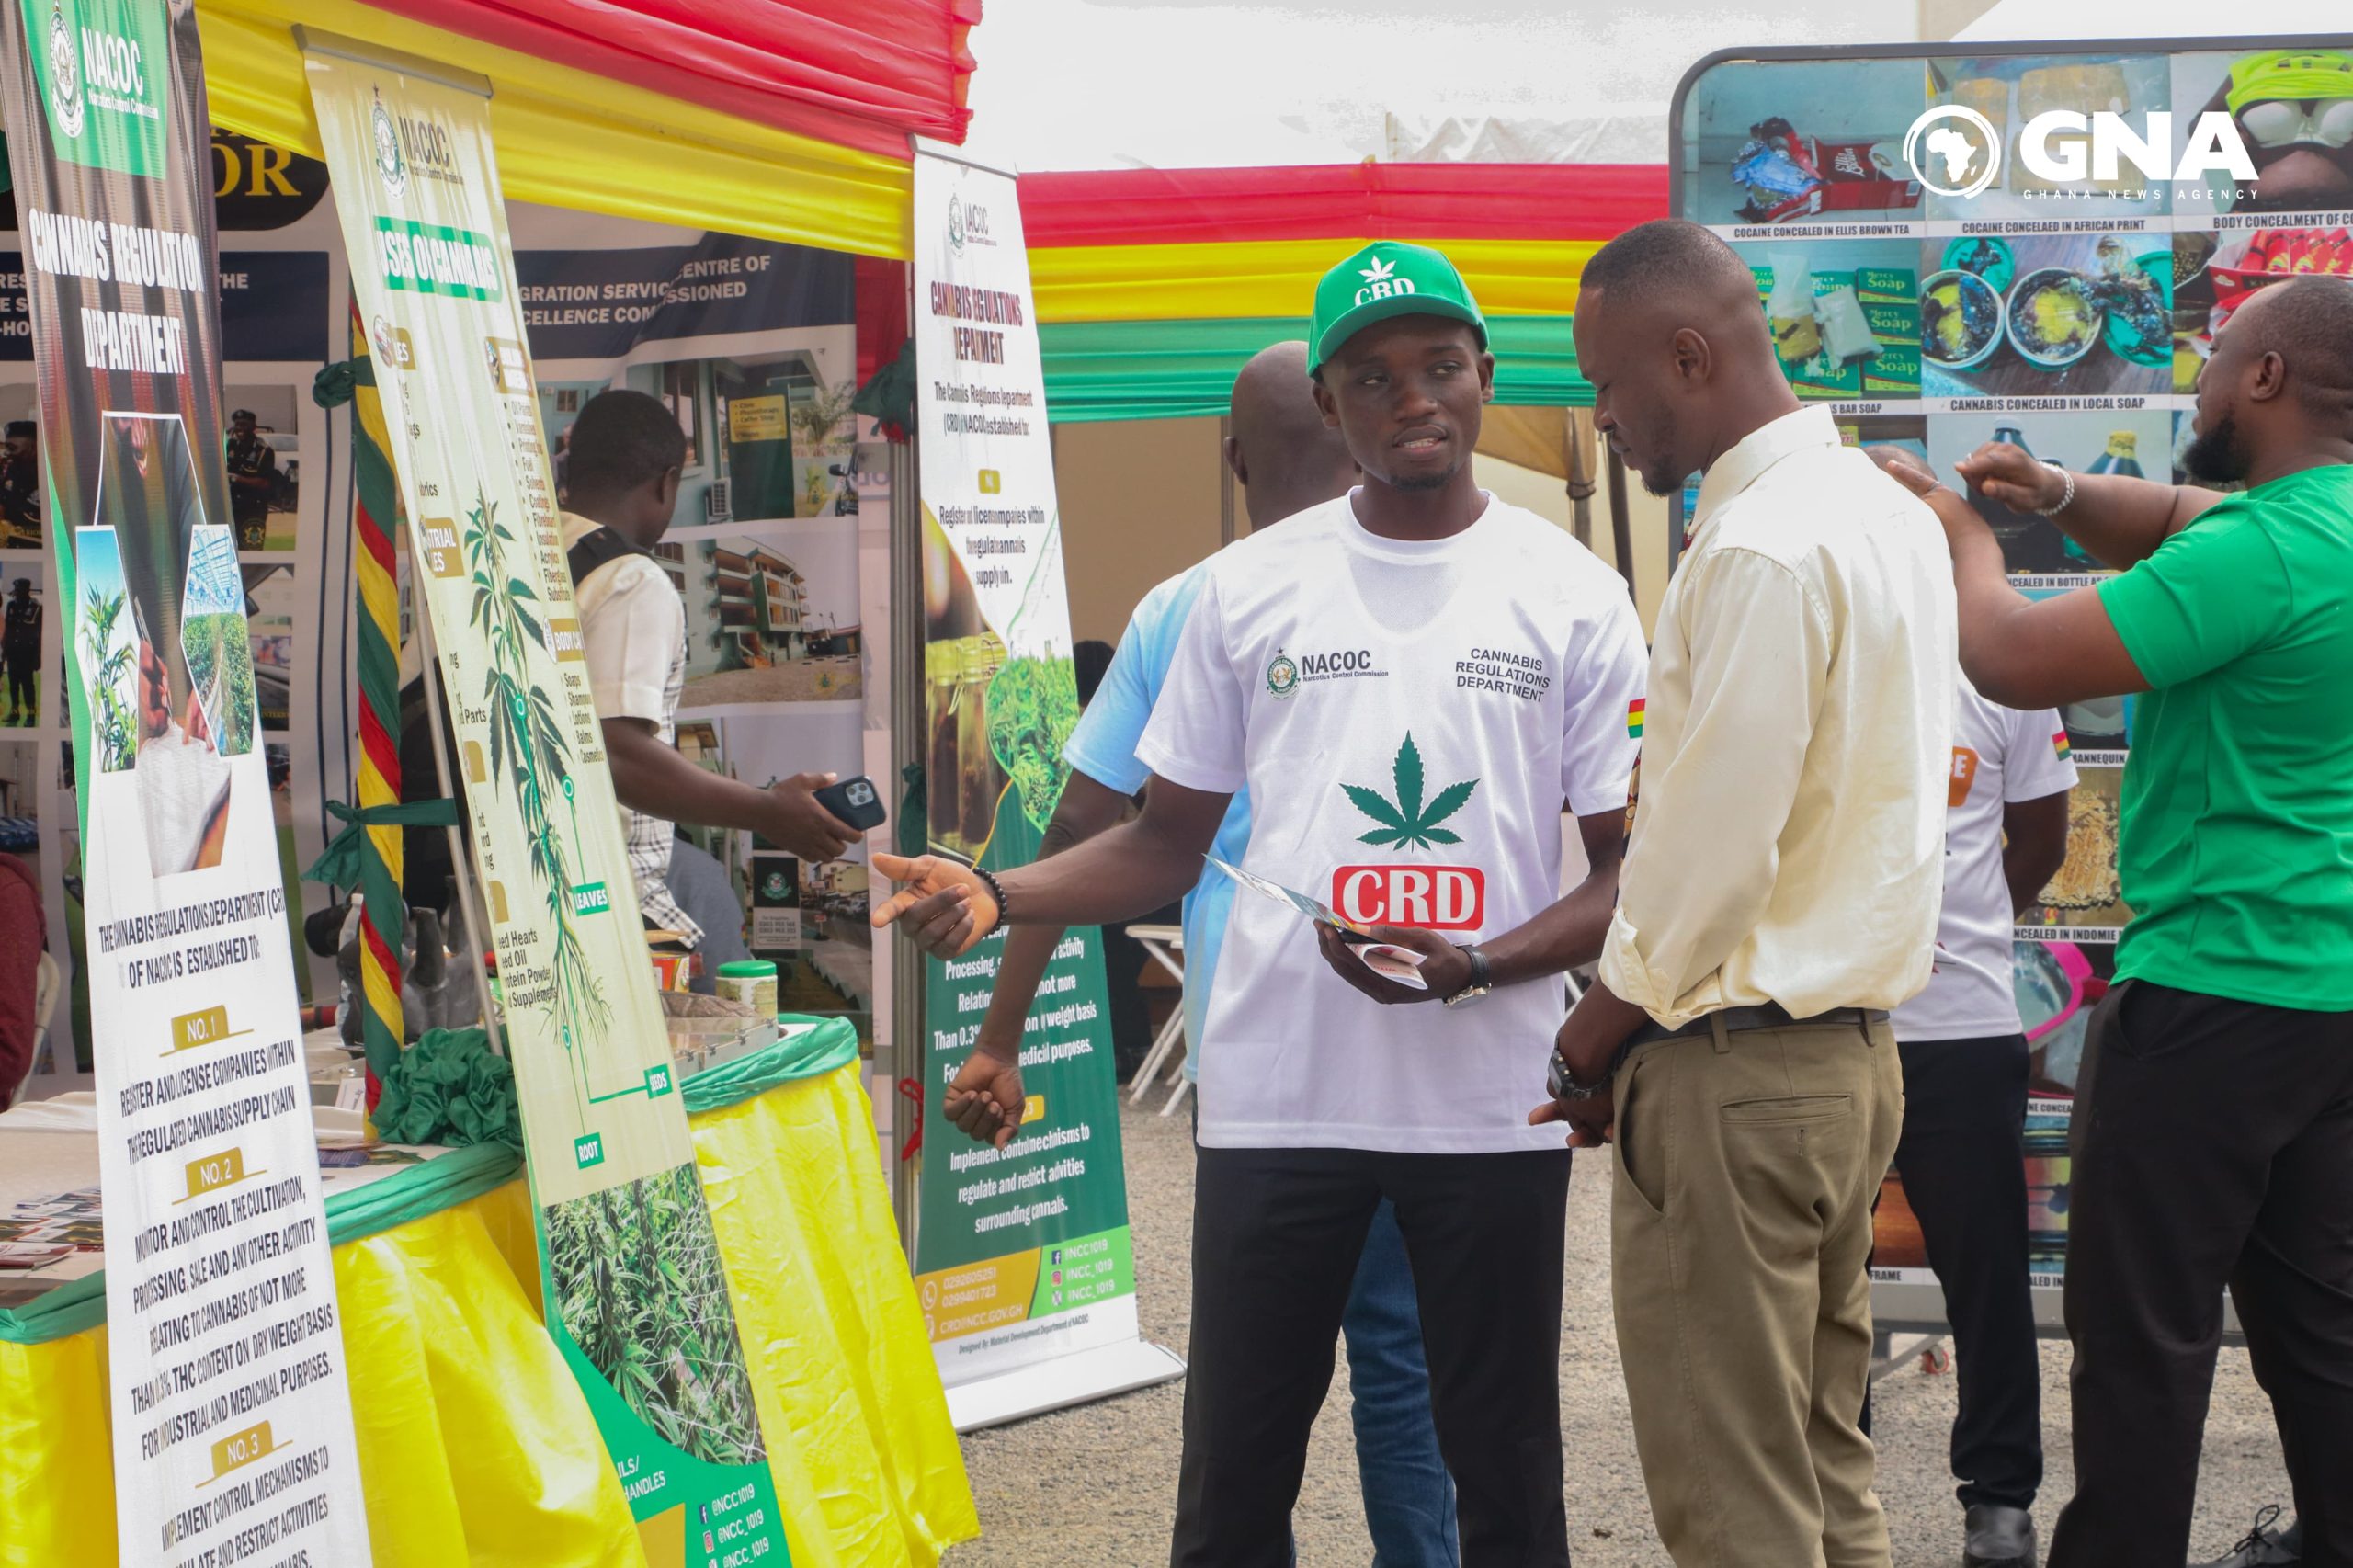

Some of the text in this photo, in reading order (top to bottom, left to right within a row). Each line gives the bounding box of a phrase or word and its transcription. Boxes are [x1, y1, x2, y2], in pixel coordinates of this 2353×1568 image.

[81, 27, 143, 96] NACOC
[1734, 224, 1910, 238] COCAINE CONCEALED IN ELLIS BROWN TEA
[1962, 222, 2001, 233] COCAINE
[2061, 221, 2072, 232] IN
[2073, 219, 2115, 232] AFRICAN
[2116, 219, 2145, 231] PRINT
[2213, 217, 2243, 229] BODY
[2245, 214, 2323, 228] CONCEALMENT
[2326, 213, 2340, 226] OF
[681, 255, 771, 278] ENTRE OF
[1867, 278, 1906, 291] Soap
[1871, 316, 1913, 331] Soap
[1875, 359, 1918, 375] Soap
[934, 381, 947, 401] The
[1950, 397, 2145, 411] CANNABIS CONCEALED IN LOCAL SOAP
[1839, 404, 1882, 414] BAR SOAP
[2046, 577, 2089, 587] IN BOTTLE
[1302, 650, 1371, 676] NACOC
[1471, 647, 1543, 671] CANNABIS
[563, 672, 582, 689] Soaps
[1302, 675, 1330, 683] Narcotics
[1354, 670, 1389, 678] Commission
[1455, 661, 1551, 689] REGULATIONS
[1456, 676, 1544, 704] DEPARTMENT
[465, 708, 487, 725] Parts
[1343, 869, 1476, 924] CRD
[99, 891, 265, 954] THE REGULATIONS DEPARTMENT
[2059, 929, 2070, 940] IN
[2073, 929, 2116, 941] INDOMIE
[512, 928, 538, 948] Hearts
[1058, 937, 1085, 960] activity
[129, 936, 248, 989] OF NACOC IS ESTABLISHED
[515, 948, 528, 965] Oil
[945, 955, 996, 981] Processing,
[1057, 973, 1076, 993] more
[958, 989, 993, 1013] Relatin
[1024, 1016, 1038, 1032] on
[1045, 1003, 1076, 1029] weight
[1076, 999, 1097, 1022] basis
[187, 1015, 216, 1043] NO. 1
[934, 1029, 958, 1051] Than
[1051, 1038, 1093, 1064] purposes.
[120, 1040, 296, 1118] REGISTER AND LICENSE COMPANIES WITHIN
[137, 1085, 296, 1160] REGULATED CANNABIS SUPPLY CHAIN
[578, 1140, 598, 1163] ROOT
[950, 1121, 1090, 1173] Implement to
[200, 1157, 233, 1187] NO. 2
[958, 1177, 997, 1206] regulate
[998, 1172, 1017, 1194] and
[134, 1175, 307, 1264] MONITOR AND CONTROL THE CULTIVATION,
[975, 1203, 1031, 1233] surrounding
[189, 1257, 209, 1290] SALE
[208, 1249, 230, 1283] AND
[232, 1243, 248, 1274] ANY
[248, 1231, 281, 1265] OTHER
[282, 1216, 316, 1255] ACTIVITY
[190, 1311, 201, 1338] TO
[201, 1290, 248, 1333] CANNABIS
[248, 1285, 259, 1312] OF
[259, 1278, 279, 1307] NOT
[282, 1267, 307, 1301] MORE
[131, 1303, 334, 1415] THAN THC CONTENT ON DRY WEIGHT BASIS
[142, 1428, 160, 1461] FOR
[210, 1394, 229, 1426] AND
[229, 1372, 279, 1418] MEDICINAL
[280, 1351, 333, 1395] PURPOSES.
[227, 1433, 258, 1465] NO. 3
[161, 1444, 329, 1552] IMPLEMENT CONTROL MECHANISMS TO
[711, 1483, 756, 1517] @NCC1019
[217, 1539, 234, 1568] AND
[235, 1515, 279, 1561] RESTRICT
[281, 1492, 329, 1540] ACTIVITIES
[717, 1508, 765, 1545] @NCC_1019
